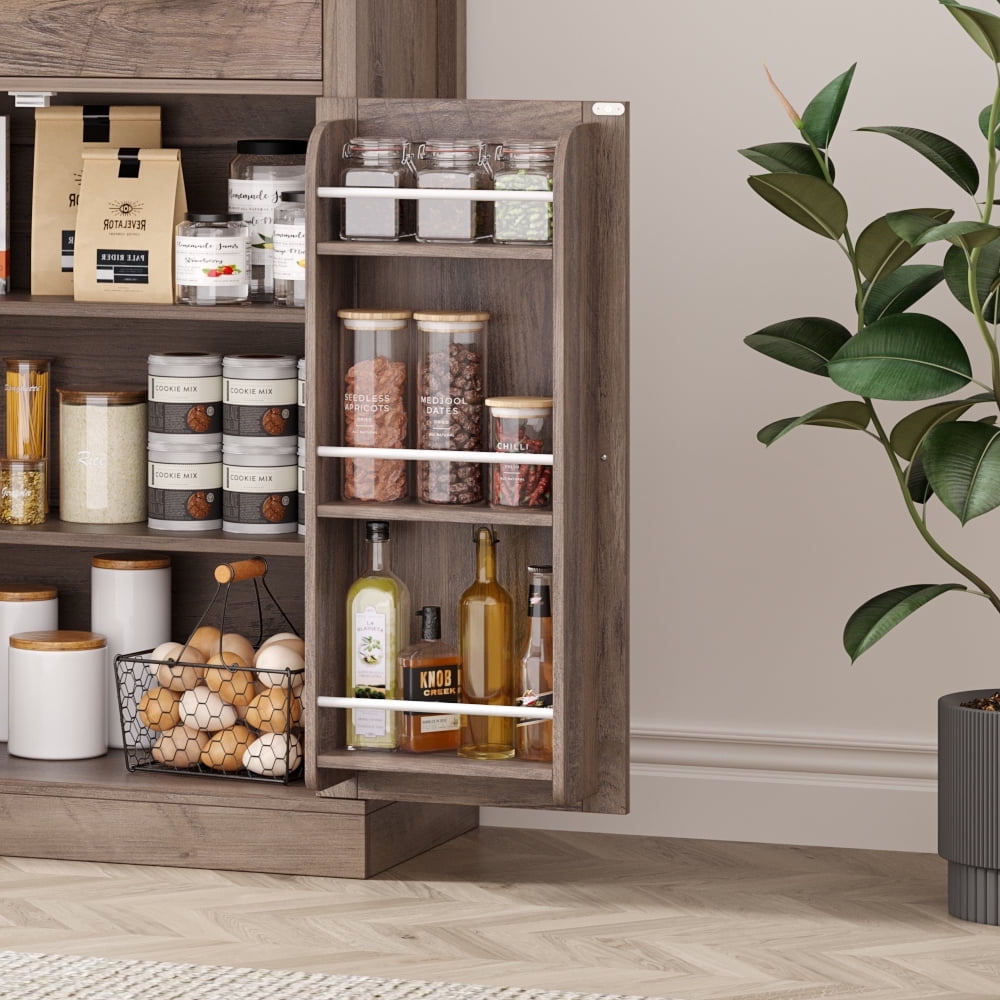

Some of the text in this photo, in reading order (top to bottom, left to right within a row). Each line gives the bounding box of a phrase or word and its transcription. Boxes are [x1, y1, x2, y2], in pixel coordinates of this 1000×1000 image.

[155, 384, 181, 392] COOKIE
[230, 387, 256, 395] COOKIE
[344, 393, 390, 403] SEEDLESS
[344, 403, 390, 413] APRICOTS
[426, 406, 459, 415] DATES
[496, 442, 529, 450] CHILLI
[155, 471, 181, 479] COOKIE
[230, 474, 256, 482] COOKIE
[420, 669, 452, 689] KNOB
[423, 687, 456, 697] CREEK
